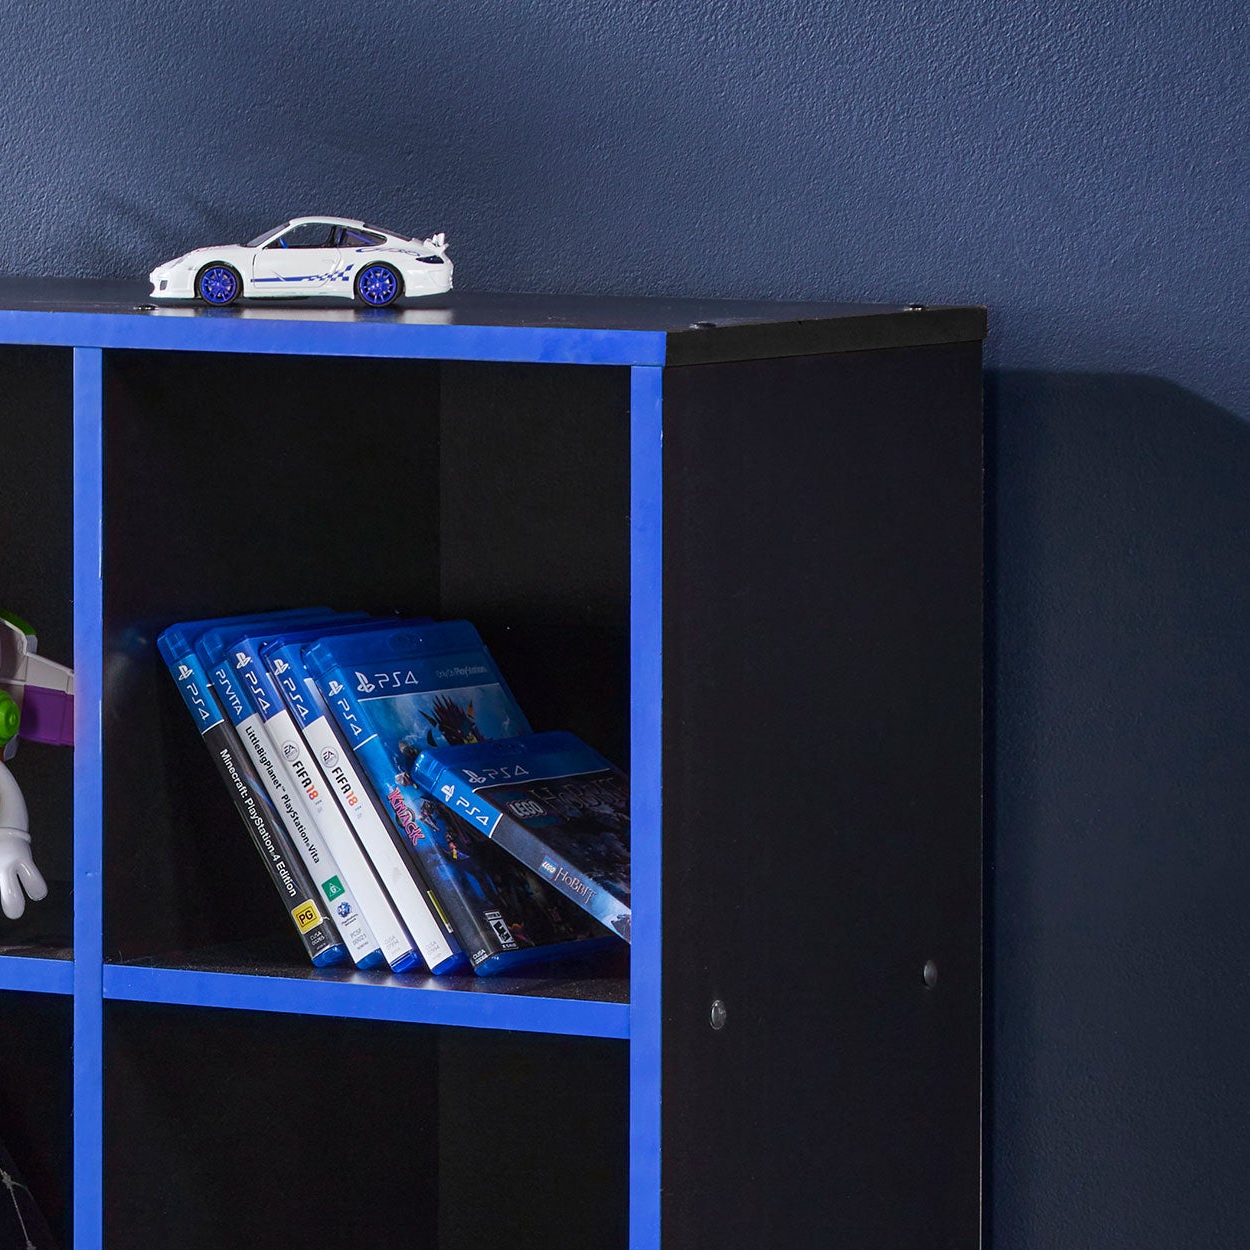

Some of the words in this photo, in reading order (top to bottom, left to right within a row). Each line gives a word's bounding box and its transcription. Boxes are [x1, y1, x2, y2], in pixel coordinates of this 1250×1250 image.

[245, 671, 271, 713] PS4
[374, 671, 419, 688] PS4
[186, 683, 210, 720] PS4
[283, 677, 309, 718] PS4
[338, 698, 363, 736] PS4
[482, 765, 529, 780] PS4
[220, 749, 248, 799] Minecraft:
[276, 861, 297, 897] Edition
[387, 786, 425, 846] KNACK
[456, 797, 490, 825] PS4
[508, 799, 546, 819] LEGO
[541, 861, 557, 874] LEGO
[298, 910, 313, 924] PG
